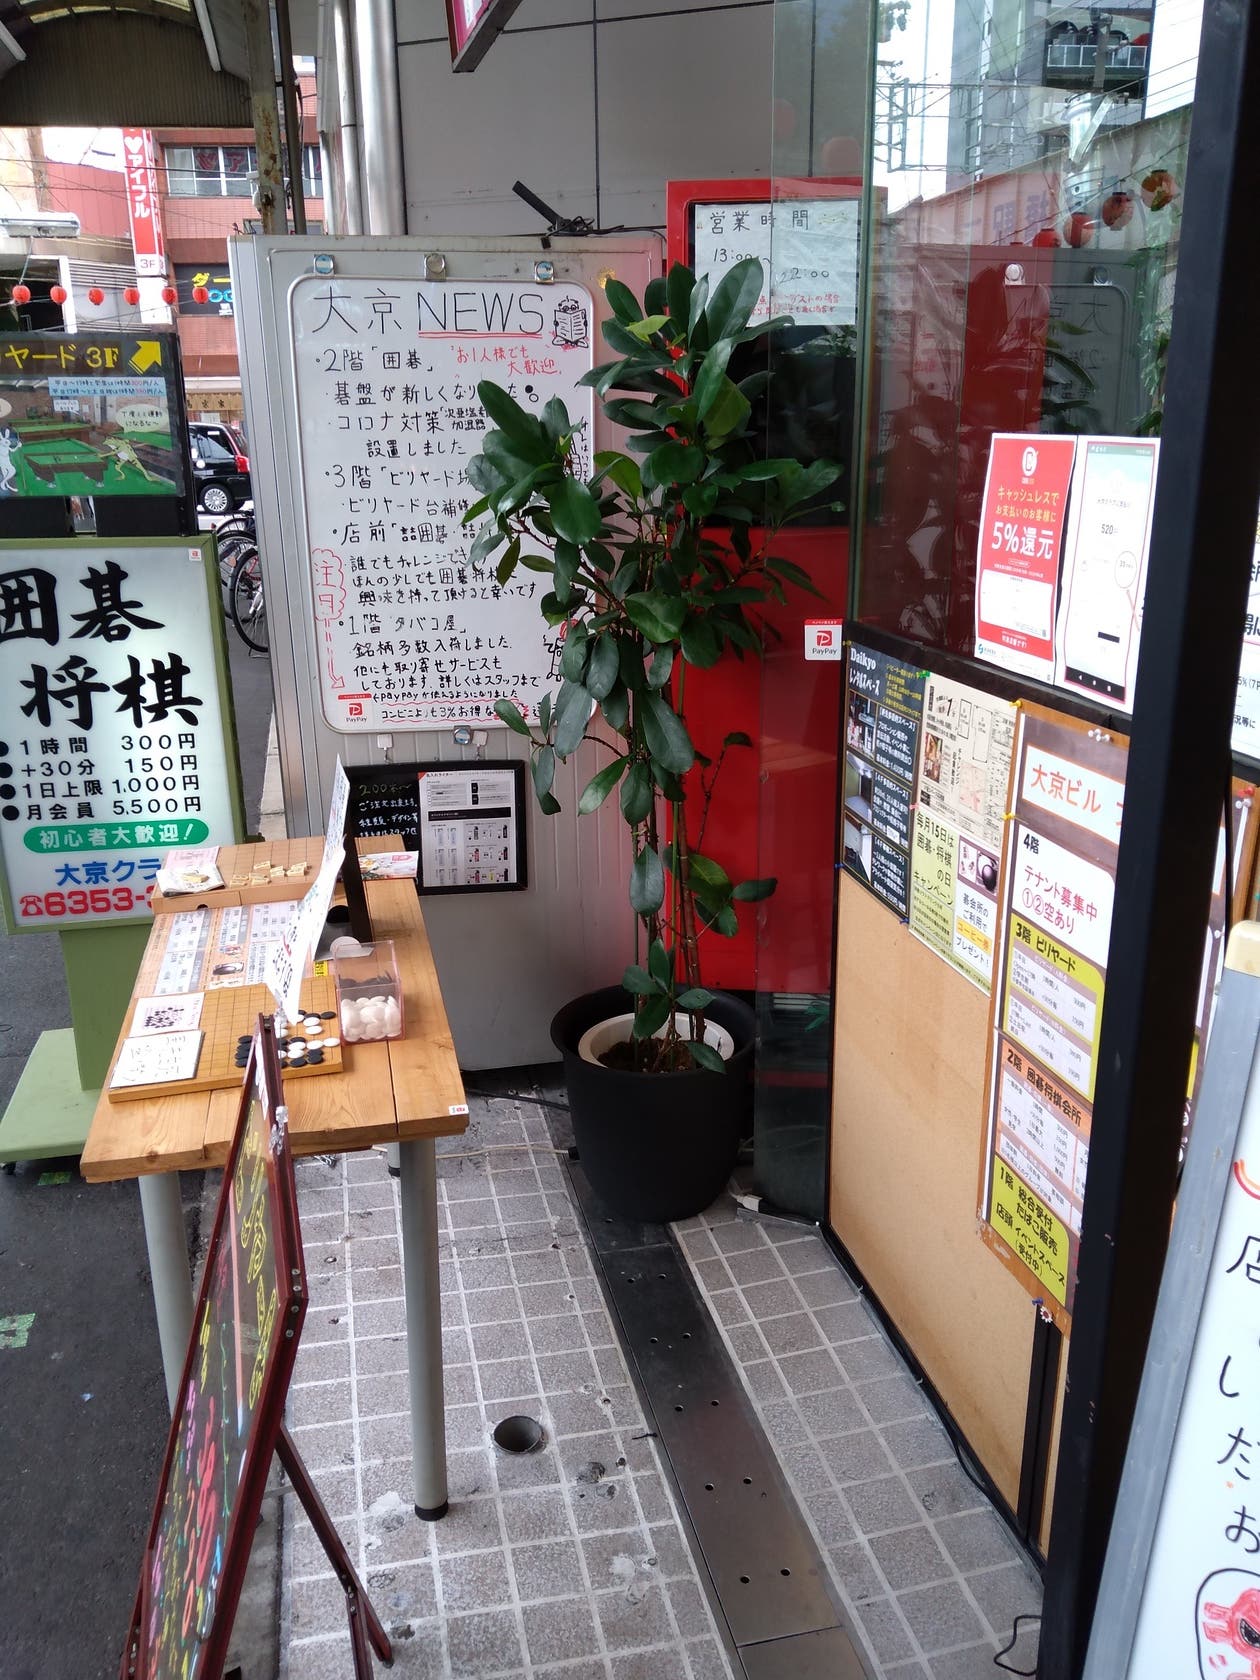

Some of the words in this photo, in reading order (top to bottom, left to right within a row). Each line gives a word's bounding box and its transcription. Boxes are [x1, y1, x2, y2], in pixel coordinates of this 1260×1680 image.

[128, 154, 151, 218] アイフル
[710, 209, 809, 235] 営業時間
[140, 258, 157, 269] 3F
[312, 287, 402, 334] 大京
[418, 291, 544, 334] NEWS
[5, 343, 77, 369] ヤード
[86, 346, 119, 368] 3F
[338, 411, 445, 434] コロナ対策
[366, 439, 467, 459] 設置しました
[997, 484, 1060, 506] キャッシュレスで
[995, 504, 1057, 523] お支払いのお客様に
[991, 521, 1054, 560] 5%還元
[1101, 523, 1114, 535] 520
[0, 560, 165, 646] 囲碁
[812, 647, 838, 656] PayPay
[850, 647, 877, 671] Daikyo
[353, 656, 502, 677] 他にも取り寄せサービスも
[19, 652, 204, 731] 将棋
[439, 674, 541, 688] 詳しくはスタッフまで
[20, 737, 88, 756] 1時間
[121, 733, 196, 750] 300円
[21, 758, 96, 777] +30分
[123, 754, 198, 773] 150円
[22, 779, 103, 799] 1日上限
[1030, 763, 1102, 814] 大京ビル
[26, 802, 95, 820] 月会員
[39, 819, 194, 848] 初心者大歓迎!
[916, 812, 954, 848] 毎月15日は
[917, 832, 953, 869] 囲碁・将棋
[1023, 832, 1040, 855] 4階
[914, 870, 953, 906] キャンペーン
[936, 869, 952, 888] の日
[963, 892, 989, 918] 碁会所の
[1024, 865, 1098, 922] テナント募集中
[962, 910, 988, 933] ご利用で
[1016, 922, 1032, 945] 3階
[1036, 935, 1077, 973] ビリヤード
[1007, 1048, 1023, 1073] 2階
[1026, 1066, 1082, 1128] 囲碁将棋会所
[999, 1166, 1014, 1192] 1階
[1018, 1185, 1054, 1232] 総合受付
[1016, 1205, 1058, 1257] たばこ販売
[996, 1202, 1013, 1230] 店頭
[1014, 1223, 1066, 1287] イベントスペース
